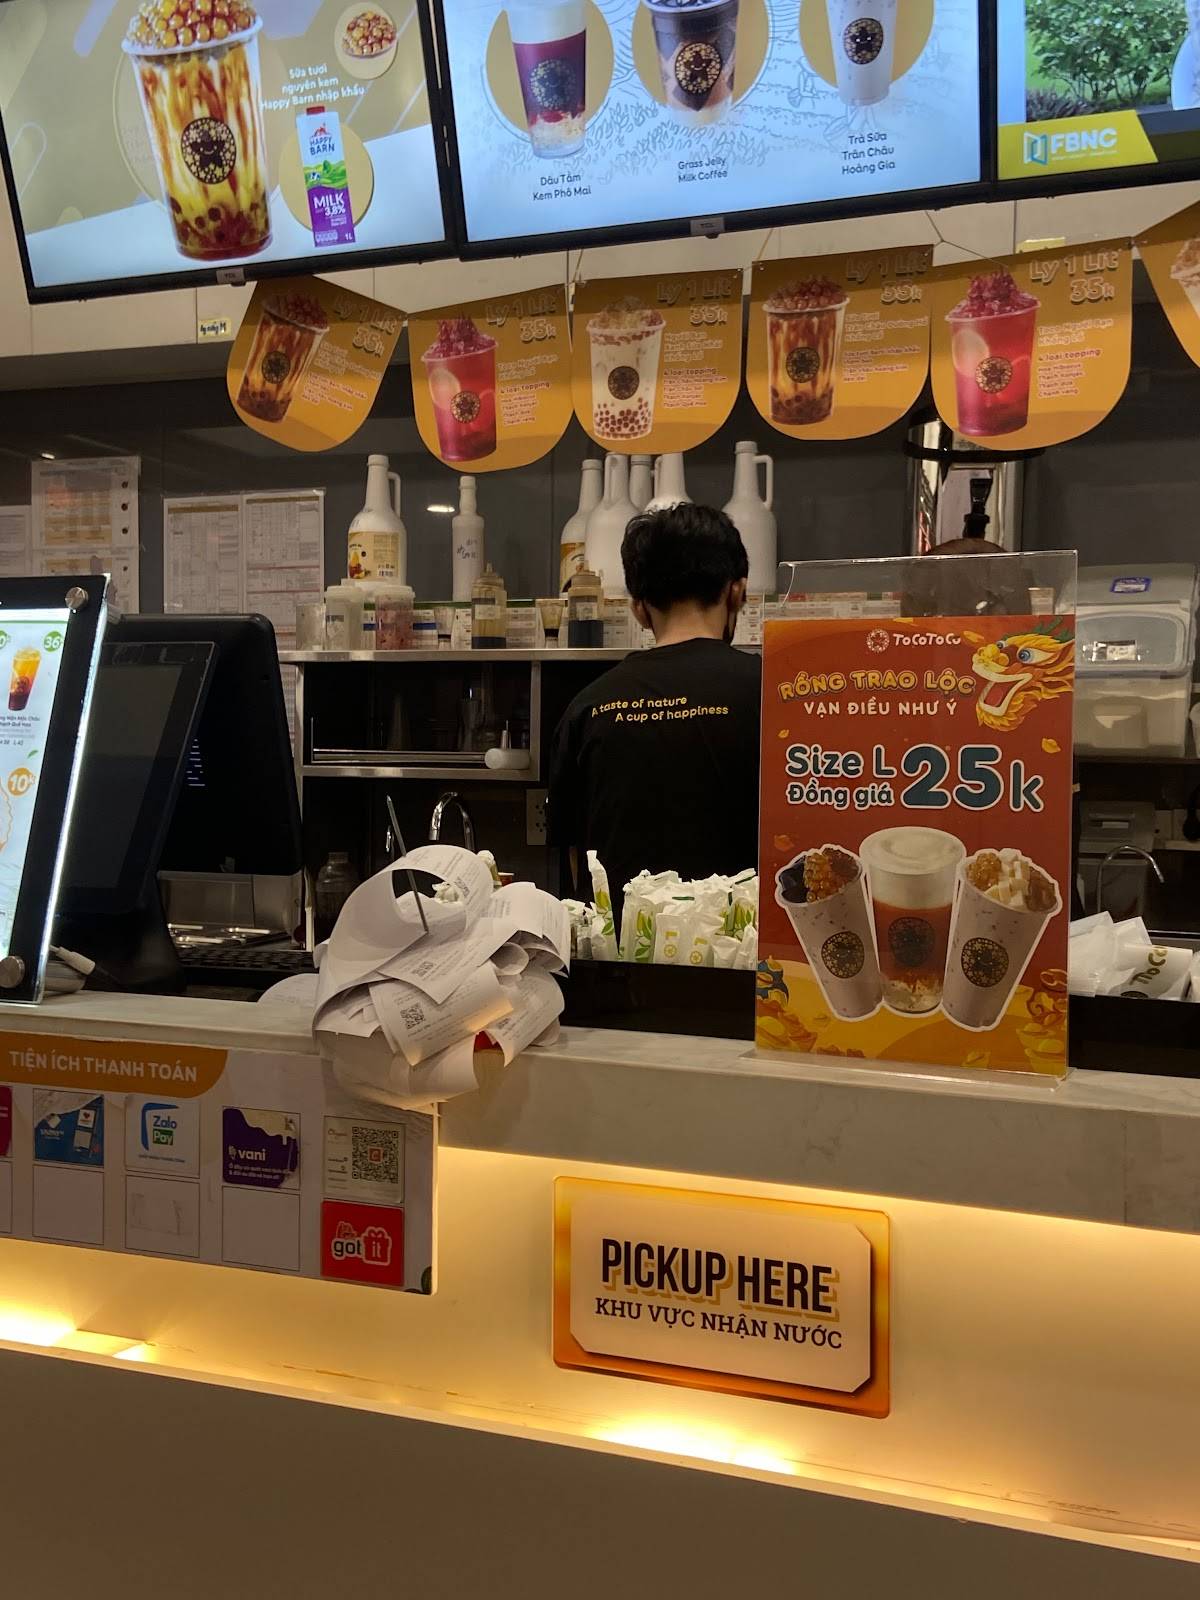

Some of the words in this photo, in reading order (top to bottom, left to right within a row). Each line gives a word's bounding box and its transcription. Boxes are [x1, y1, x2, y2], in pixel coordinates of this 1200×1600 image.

[259, 98, 290, 112] Happy
[292, 95, 314, 105] Barn
[309, 136, 332, 148] HAPPY
[848, 132, 865, 144] Trà
[1051, 127, 1118, 154] FBNC
[310, 143, 335, 156] BARN
[867, 145, 894, 158] Châu
[678, 160, 703, 169] Grass
[705, 156, 727, 168] Jelly
[878, 160, 896, 170] Gia
[678, 173, 697, 183] Milk
[698, 169, 728, 180] Coffee
[313, 192, 345, 209] MILK
[533, 190, 553, 201] Kem
[554, 187, 572, 198] Phô
[574, 185, 592, 197] Mai
[1029, 259, 1059, 286] Ly
[1064, 256, 1076, 277] 1
[1065, 349, 1101, 359] topping
[686, 368, 717, 376] topping
[522, 382, 550, 392] topping
[778, 670, 846, 701] RỒNG
[850, 670, 918, 692] TRAO
[924, 667, 975, 697] LỘC
[591, 707, 599, 718] A
[599, 699, 629, 713] taste
[631, 698, 645, 709] of
[647, 696, 688, 709] nature
[615, 712, 624, 722] A
[626, 712, 649, 723] cup
[651, 710, 665, 721] of
[667, 705, 729, 720] happiness
[803, 701, 840, 718] VẠN
[847, 696, 890, 716] ĐIỀU
[899, 700, 939, 716] NHƯ
[946, 698, 957, 716] Ý
[786, 743, 864, 778] Size
[873, 743, 897, 779] L
[900, 743, 1044, 812] 25k
[786, 779, 851, 811] Đồng
[853, 783, 895, 810] giá
[8, 1048, 48, 1072] TIỆN
[51, 1049, 81, 1072] ÍCH
[83, 1056, 145, 1078] THANH
[147, 1060, 197, 1082] TOÁN
[153, 1115, 177, 1129] Zalo
[154, 1130, 173, 1145] Pay
[238, 1148, 266, 1161] vani
[333, 1239, 362, 1258] got
[372, 1241, 381, 1258] it
[601, 1237, 730, 1298] PICKUP
[737, 1254, 834, 1316] HERE
[594, 1297, 642, 1320] KHU
[647, 1304, 695, 1330] VỰC
[701, 1313, 768, 1340] NHẬN
[774, 1323, 843, 1350] NƯỚC
